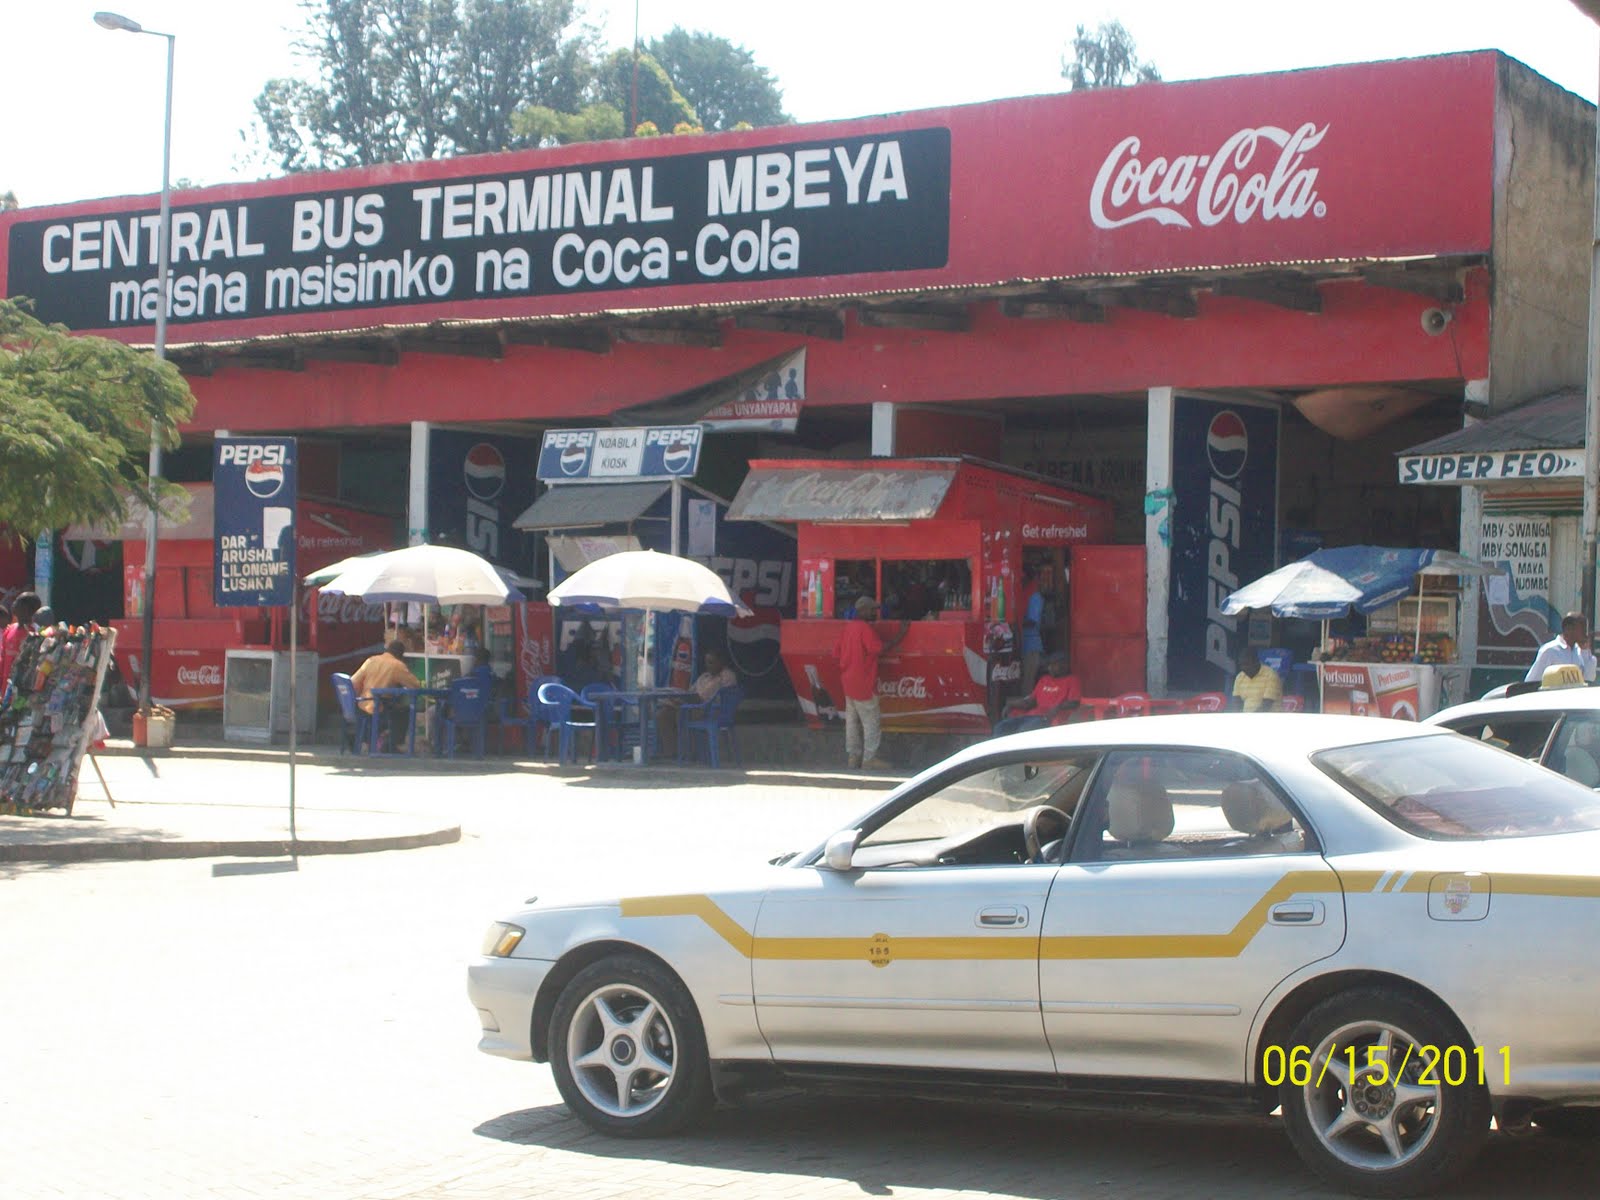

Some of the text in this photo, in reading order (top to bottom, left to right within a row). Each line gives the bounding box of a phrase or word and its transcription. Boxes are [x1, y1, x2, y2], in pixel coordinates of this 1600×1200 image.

[1090, 122, 1330, 229] Coca-Cola
[42, 140, 909, 274] CENTRAL BUS TERMINAL MBEYA
[108, 219, 800, 322] maisha msisimko na Coca-Cola
[544, 431, 594, 448] PEPSI
[599, 433, 637, 449] NDABILA
[646, 429, 699, 446] PEPSI
[219, 445, 286, 465] PEPSI
[601, 457, 628, 469] KIOSK
[1404, 453, 1555, 481] SUPER FEO
[1022, 524, 1087, 538] Get refreshed
[222, 536, 247, 549] DAR
[1481, 542, 1547, 558] MBY-SONGEA
[222, 549, 273, 563] ARUSHA
[222, 562, 289, 577] LILONGWE
[1206, 477, 1241, 675] PEPSI
[1518, 562, 1544, 575] MAKA
[222, 578, 273, 592] LUSAKA
[1515, 577, 1549, 590] NJOMBE
[178, 665, 221, 684] Coca-Cola
[1325, 670, 1364, 684] ortsman
[1560, 670, 1581, 684] TAXI
